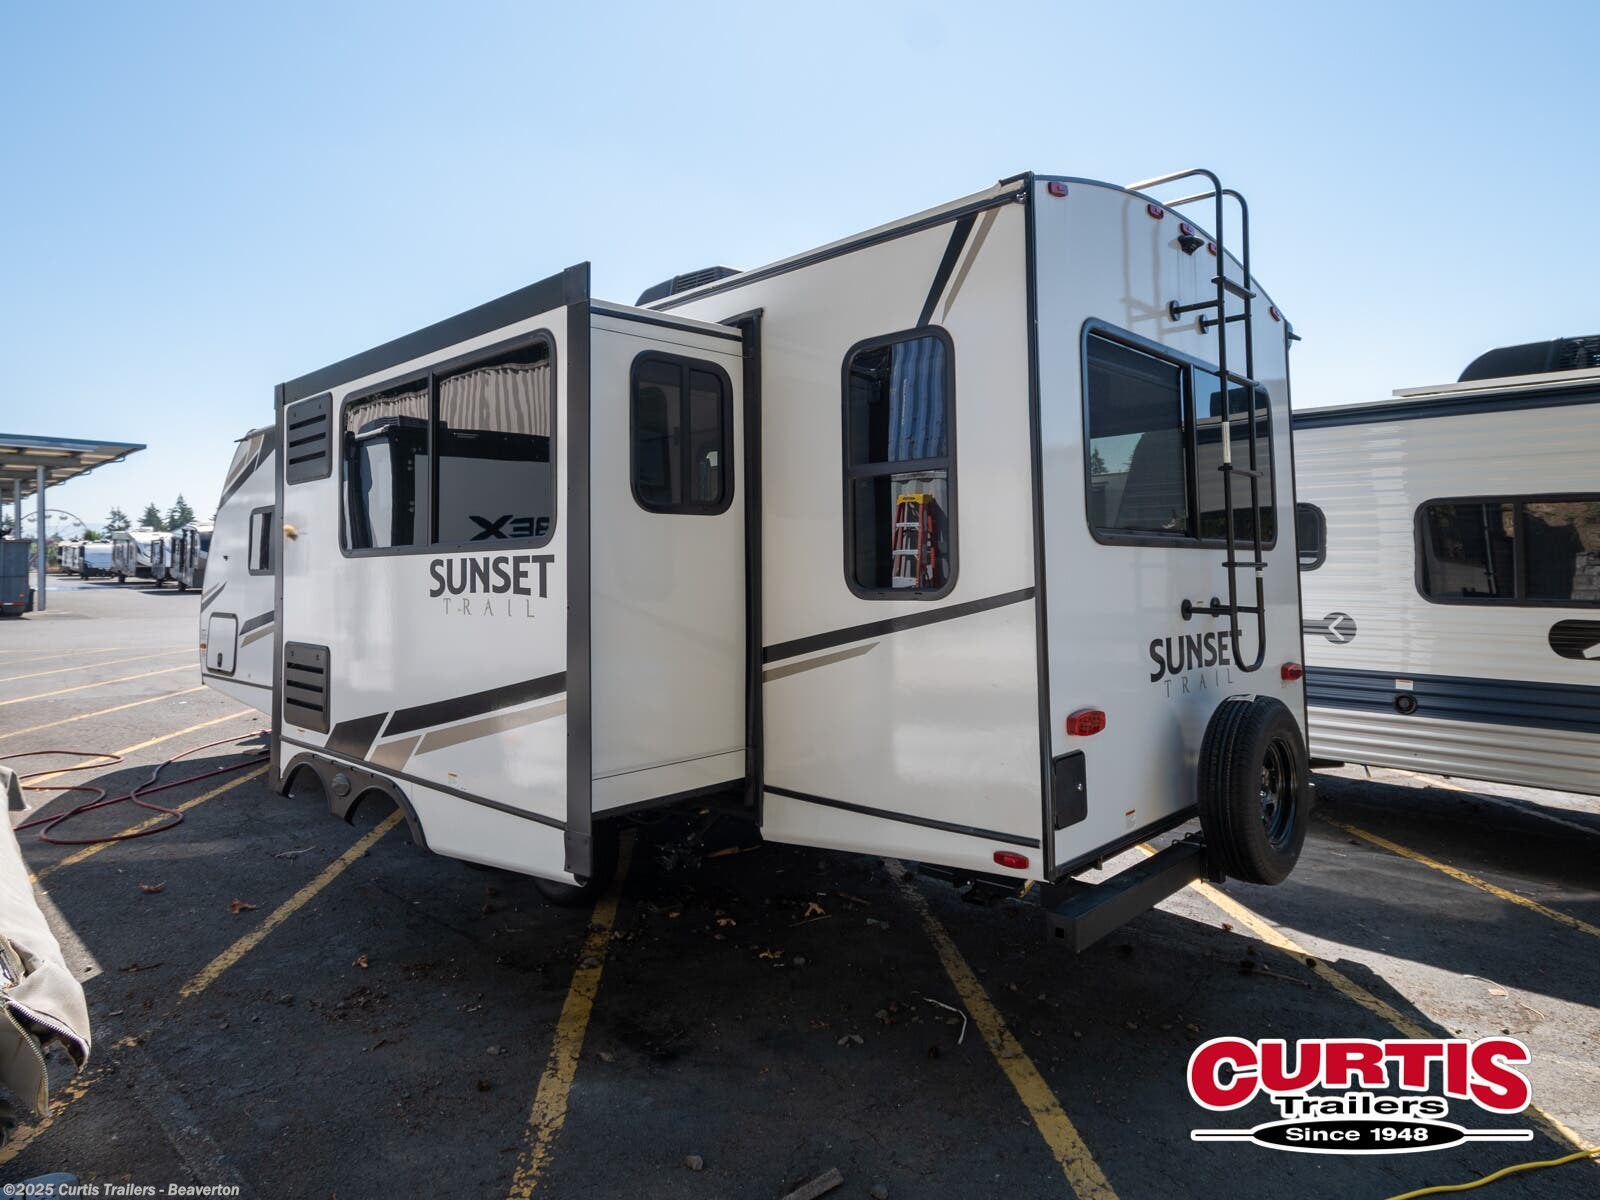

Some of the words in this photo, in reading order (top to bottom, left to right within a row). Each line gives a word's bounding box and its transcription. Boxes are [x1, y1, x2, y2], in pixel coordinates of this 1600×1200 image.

[429, 554, 555, 598] SUNSET
[443, 598, 536, 618] TRAIL
[1164, 668, 1233, 698] TRAIL
